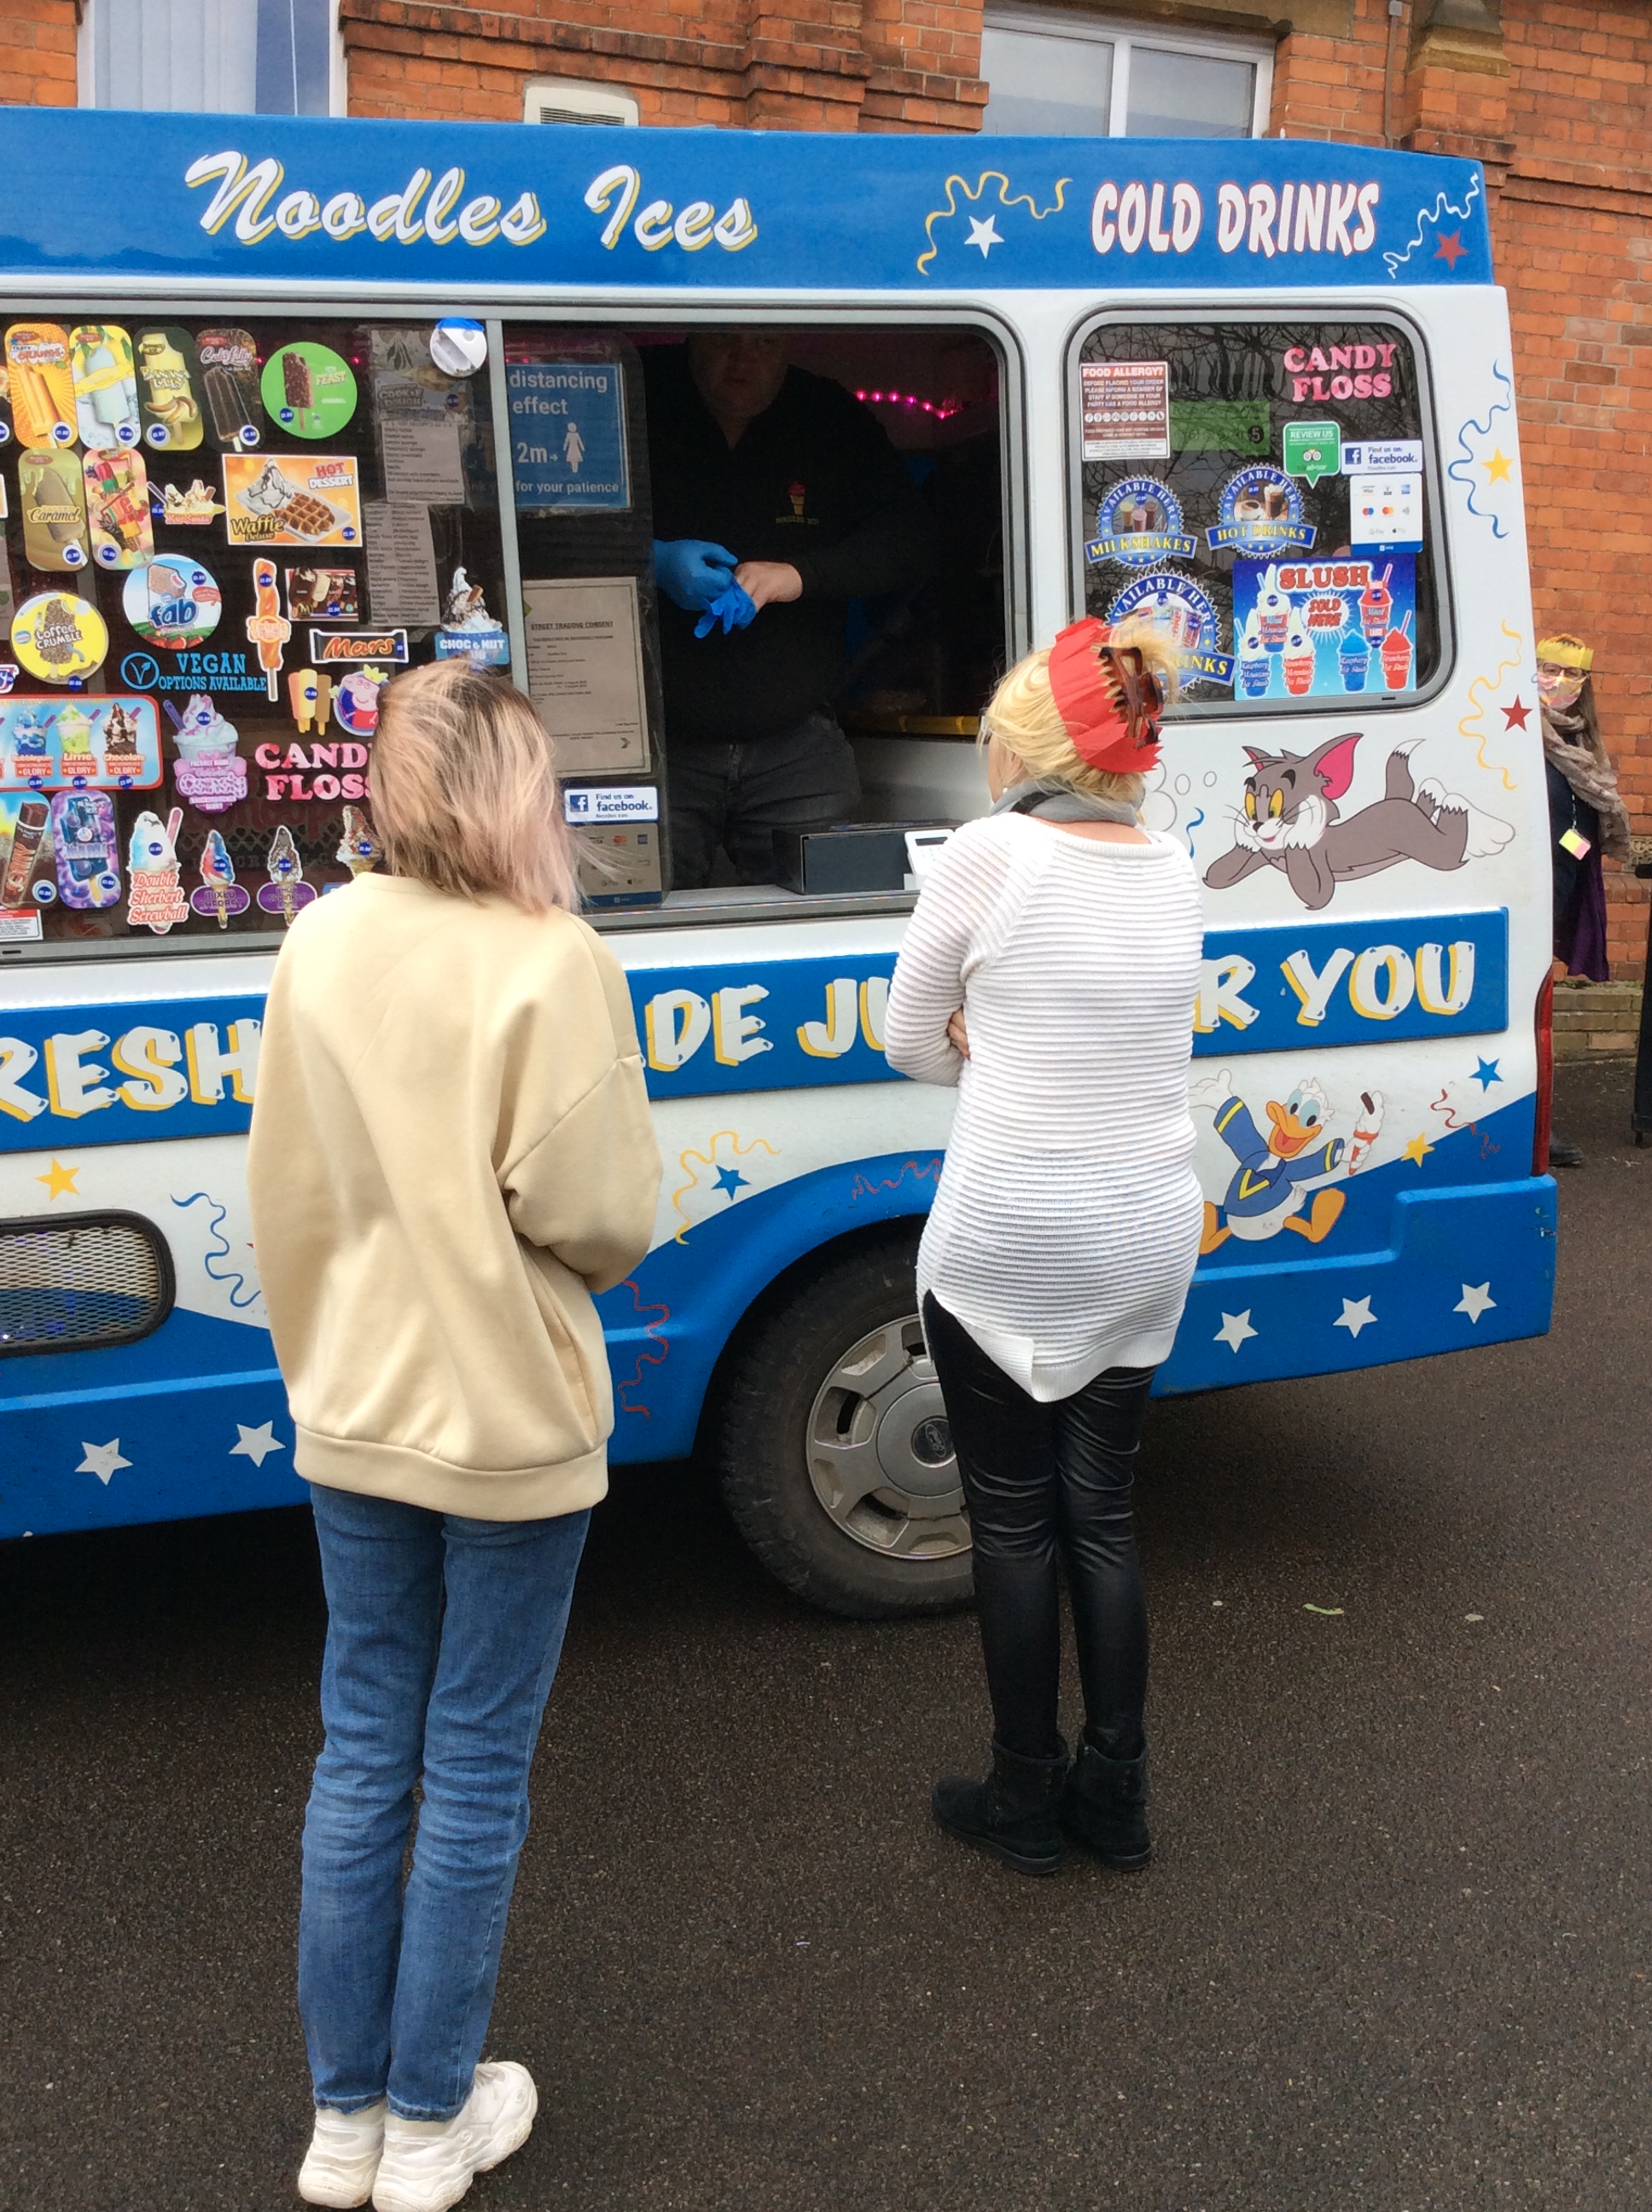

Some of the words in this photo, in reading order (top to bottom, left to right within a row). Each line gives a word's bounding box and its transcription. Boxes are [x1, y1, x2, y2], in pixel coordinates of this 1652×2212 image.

[185, 150, 547, 245] Noodles
[585, 165, 758, 251] Ices
[1091, 180, 1203, 255] COLD
[1216, 179, 1380, 258] DRINKS
[1284, 344, 1396, 372] CANDY
[317, 371, 347, 386] FEAST
[509, 370, 608, 393] distancing
[1083, 368, 1111, 378] FOOD
[1114, 367, 1164, 377] ALLERGY?
[1293, 373, 1392, 402] FLOSS
[512, 396, 569, 416] effect
[1290, 430, 1321, 439] REVIEW
[1322, 429, 1334, 438] US
[517, 442, 548, 463] 2m
[1369, 452, 1415, 464] facebook
[315, 462, 345, 476] HOT
[308, 473, 354, 490] DESSERT
[516, 481, 533, 492] for
[537, 483, 563, 495] your
[567, 481, 620, 495] patience
[1224, 470, 1277, 510] AVAILABLE
[1279, 480, 1300, 511] HERE
[1101, 482, 1155, 524] AVAILABLE
[1157, 490, 1178, 521] HERE
[30, 509, 79, 522] Caramel
[230, 515, 284, 537] Waffle
[1217, 526, 1248, 541] HOT
[1252, 524, 1306, 540] DRINKS
[1091, 536, 1191, 557] MILKSHAKES
[1280, 566, 1370, 589] SLUSH
[151, 598, 197, 627] fab
[1114, 579, 1187, 618] VAILABLE
[1188, 590, 1213, 634] HERE
[36, 624, 76, 640] toffee
[36, 631, 83, 650] CRUMBLE
[323, 637, 396, 659] Mars
[439, 640, 471, 649] CHOC
[481, 639, 505, 649] NUT
[176, 653, 247, 674] VEGAN
[159, 676, 207, 690] OPTIONS
[209, 677, 266, 692] AVAILABLE
[63, 752, 93, 761] Lime
[102, 753, 146, 762] Chocolate
[255, 742, 372, 769] CAND
[265, 773, 370, 800] FLOS
[596, 800, 649, 812] facebook
[134, 873, 177, 888] Double
[131, 890, 182, 905] Sherbert
[131, 905, 187, 923] Screwball
[0, 1018, 261, 1121] RESH
[642, 984, 775, 1072] DE
[1280, 940, 1475, 1027] YOU
